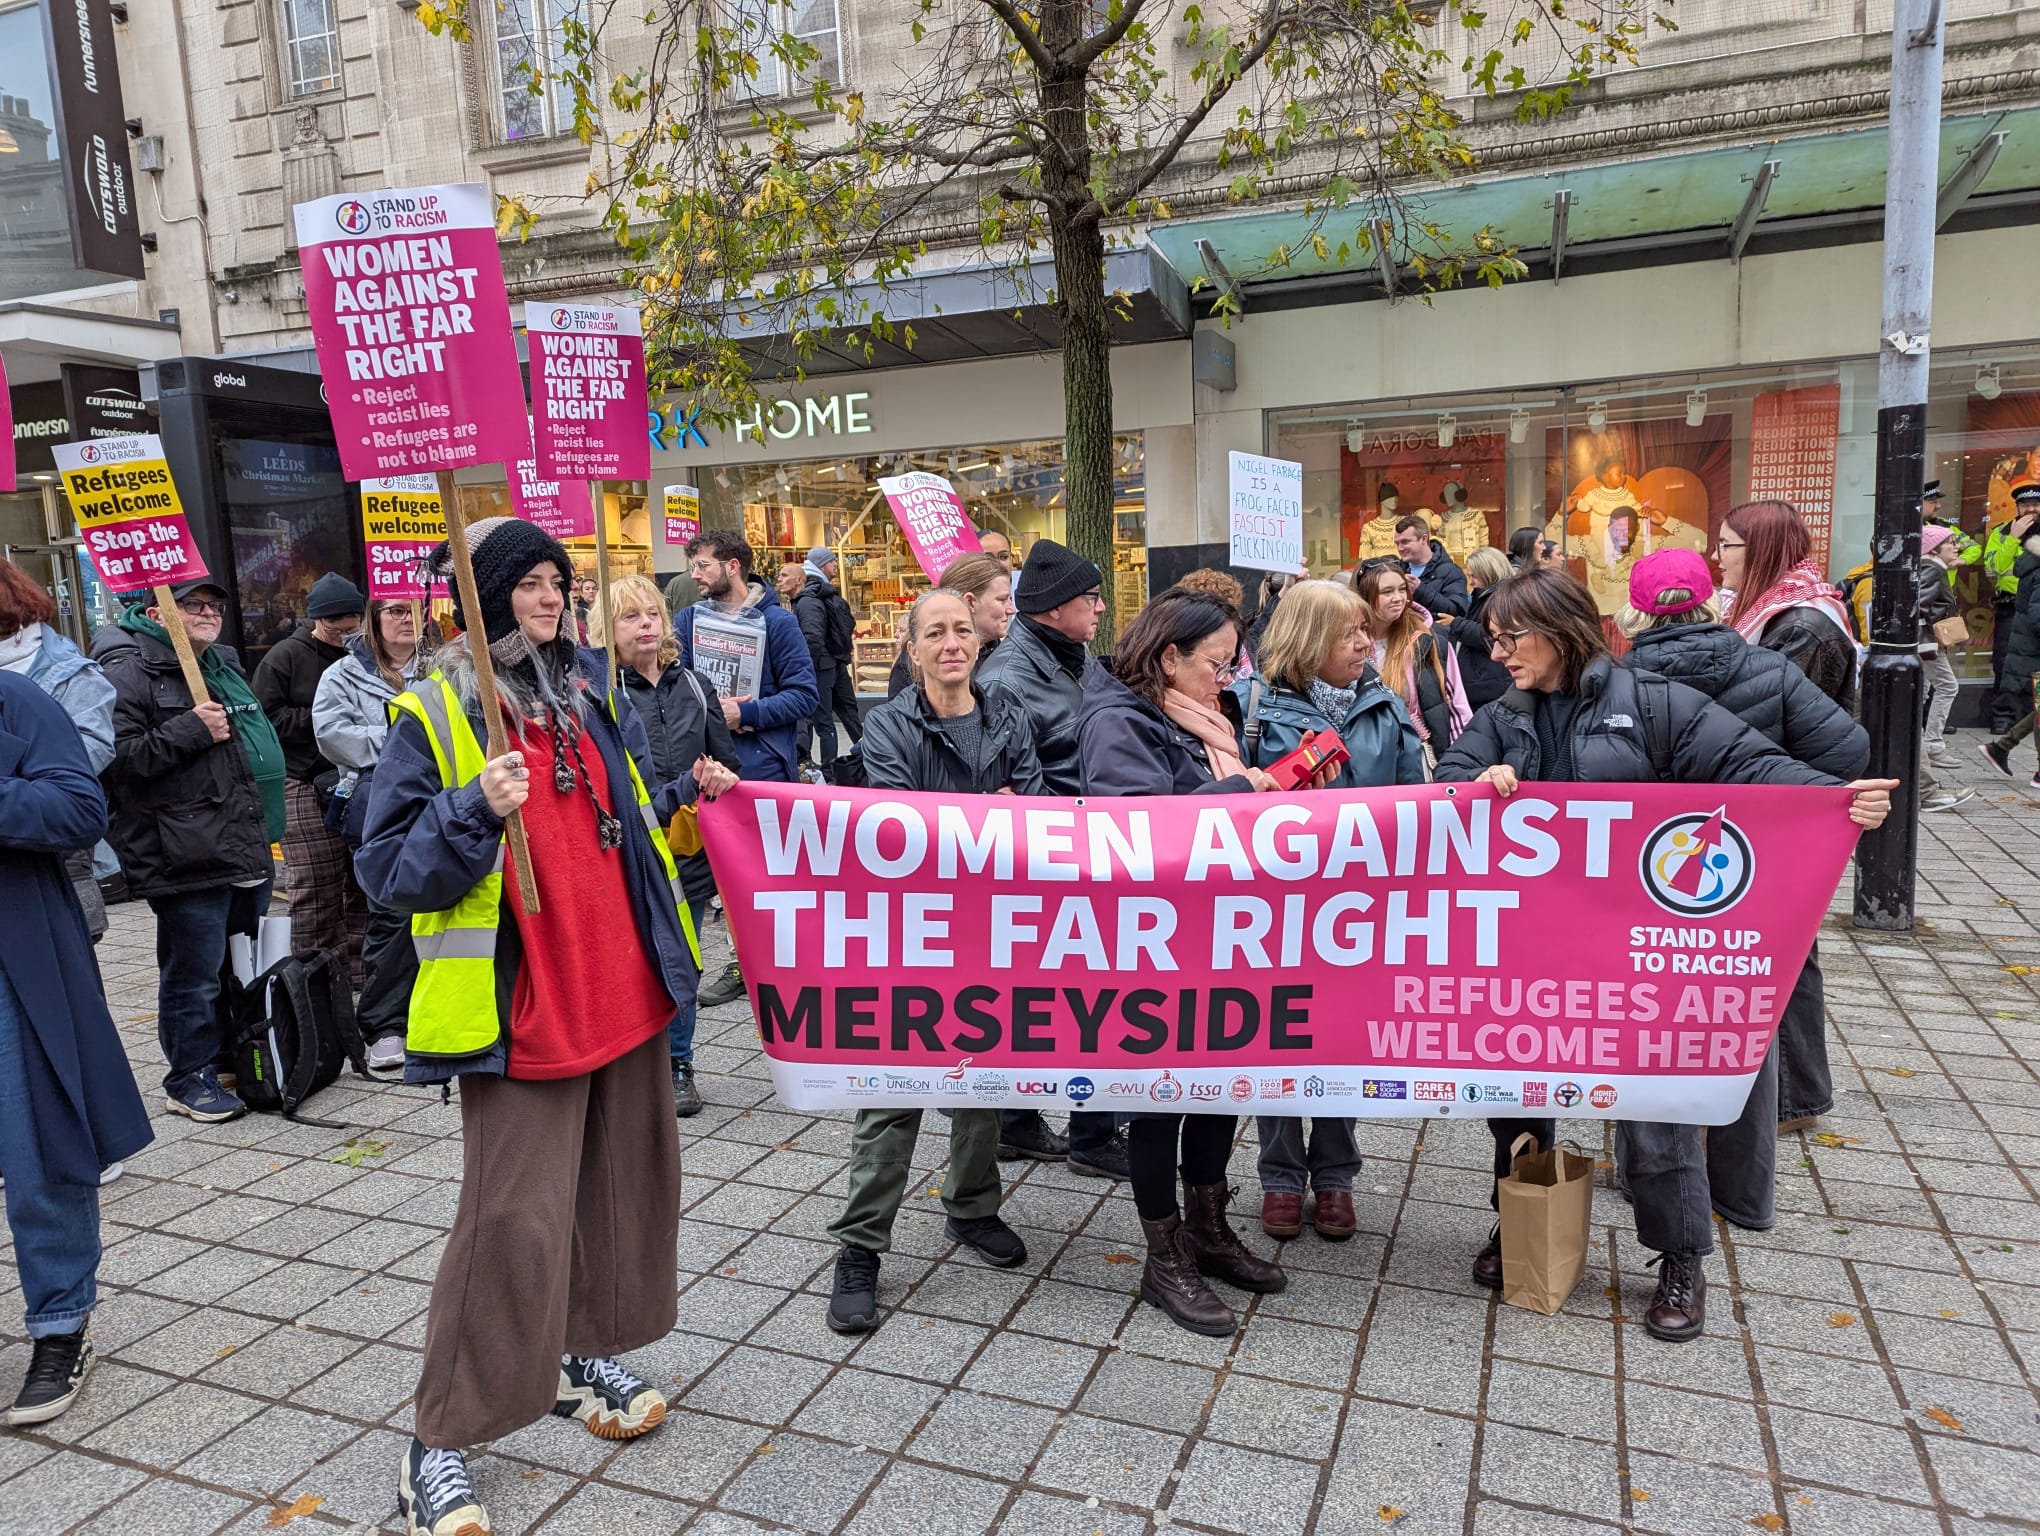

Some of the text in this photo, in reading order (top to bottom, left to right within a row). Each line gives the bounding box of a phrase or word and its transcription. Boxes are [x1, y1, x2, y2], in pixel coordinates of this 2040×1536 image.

[93, 134, 117, 234] COTSWOLD
[113, 163, 128, 215] outdoor
[373, 195, 438, 215] STAND UP
[375, 210, 448, 230] TO RACISM
[322, 236, 454, 278] WOMEN
[334, 268, 479, 312] AGAINST
[337, 303, 475, 347] THE FAR
[573, 310, 615, 322] STAND UP
[574, 320, 618, 332] TO RACISM
[540, 335, 618, 358] WOMEN
[345, 341, 446, 381] RIGHT
[543, 358, 632, 380] AGAINST
[214, 372, 246, 387] global
[544, 377, 625, 400] THE FAR
[86, 396, 146, 410] COTSWOLD
[363, 386, 418, 408] Reject
[101, 410, 133, 419] outdoor
[367, 402, 451, 426] racist lies
[546, 399, 606, 420] RIGHT
[735, 392, 871, 443] HOME
[1755, 411, 1837, 428] REDUCTIONS
[372, 422, 478, 448] Refugees are
[552, 423, 586, 437] Reject
[1754, 424, 1836, 440] REDUCTIONS
[100, 440, 139, 452] STAND UP
[553, 436, 604, 448] racist lies
[1753, 437, 1835, 452] REDUCTIONS
[104, 449, 146, 461] TO RACISM
[263, 456, 305, 471] LEEDS
[377, 441, 477, 469] not to blame
[555, 450, 619, 464] Refugees are
[1752, 450, 1834, 464] REDUCTIONS
[241, 470, 291, 482] Christmas
[556, 463, 618, 475] not to blame
[1238, 460, 1302, 481] NIGEL FARAGE
[1752, 463, 1833, 477] REDUCTIONS
[69, 467, 168, 495] Refugees
[408, 483, 433, 491] RACISM
[521, 481, 560, 498] RIGHT
[1251, 477, 1281, 493] IS A
[1751, 476, 1832, 490] REDUCTIONS
[897, 488, 950, 508] WOMEN
[1235, 491, 1299, 517] FROG FACED
[1750, 488, 1832, 502] REDUCTIONS
[79, 491, 172, 519] welcome
[367, 496, 444, 517] Refugee
[528, 499, 552, 511] Reject
[906, 501, 961, 521] AGAINST
[369, 517, 448, 534] welcome
[667, 519, 686, 530] Stop
[667, 528, 680, 538] far
[910, 514, 966, 533] THE FAR
[1234, 513, 1285, 538] FASCIST
[90, 522, 180, 553] Stop the
[916, 527, 959, 547] RIGHT
[371, 545, 415, 566] Stop
[927, 540, 953, 555] Reject
[932, 550, 954, 563] racist
[99, 547, 188, 577] far right
[373, 566, 402, 585] far
[698, 634, 727, 650] Socialist
[727, 641, 756, 655] Worker
[695, 654, 720, 672] DON'T
[720, 660, 738, 675] LET
[753, 797, 1633, 882] WOMEN AGAINST
[753, 889, 1520, 971] THE FAR RIGHT
[1630, 926, 1761, 950] STAND UP
[1630, 952, 1772, 976] TO RACISM
[1394, 976, 1774, 1024] REFUGEES ARE
[757, 983, 1313, 1053] MERSEYSIDE
[1366, 1020, 1770, 1068] WELCOME HERE
[847, 1076, 880, 1088] TUC
[887, 1080, 930, 1089] UNISON
[972, 1084, 1010, 1092] education
[1067, 1082, 1093, 1096] pcs
[1190, 1082, 1222, 1096] tssa
[1415, 1082, 1452, 1091] CARE 4
[1415, 1091, 1454, 1100] CALAIS
[1603, 1097, 1616, 1105] ALL
